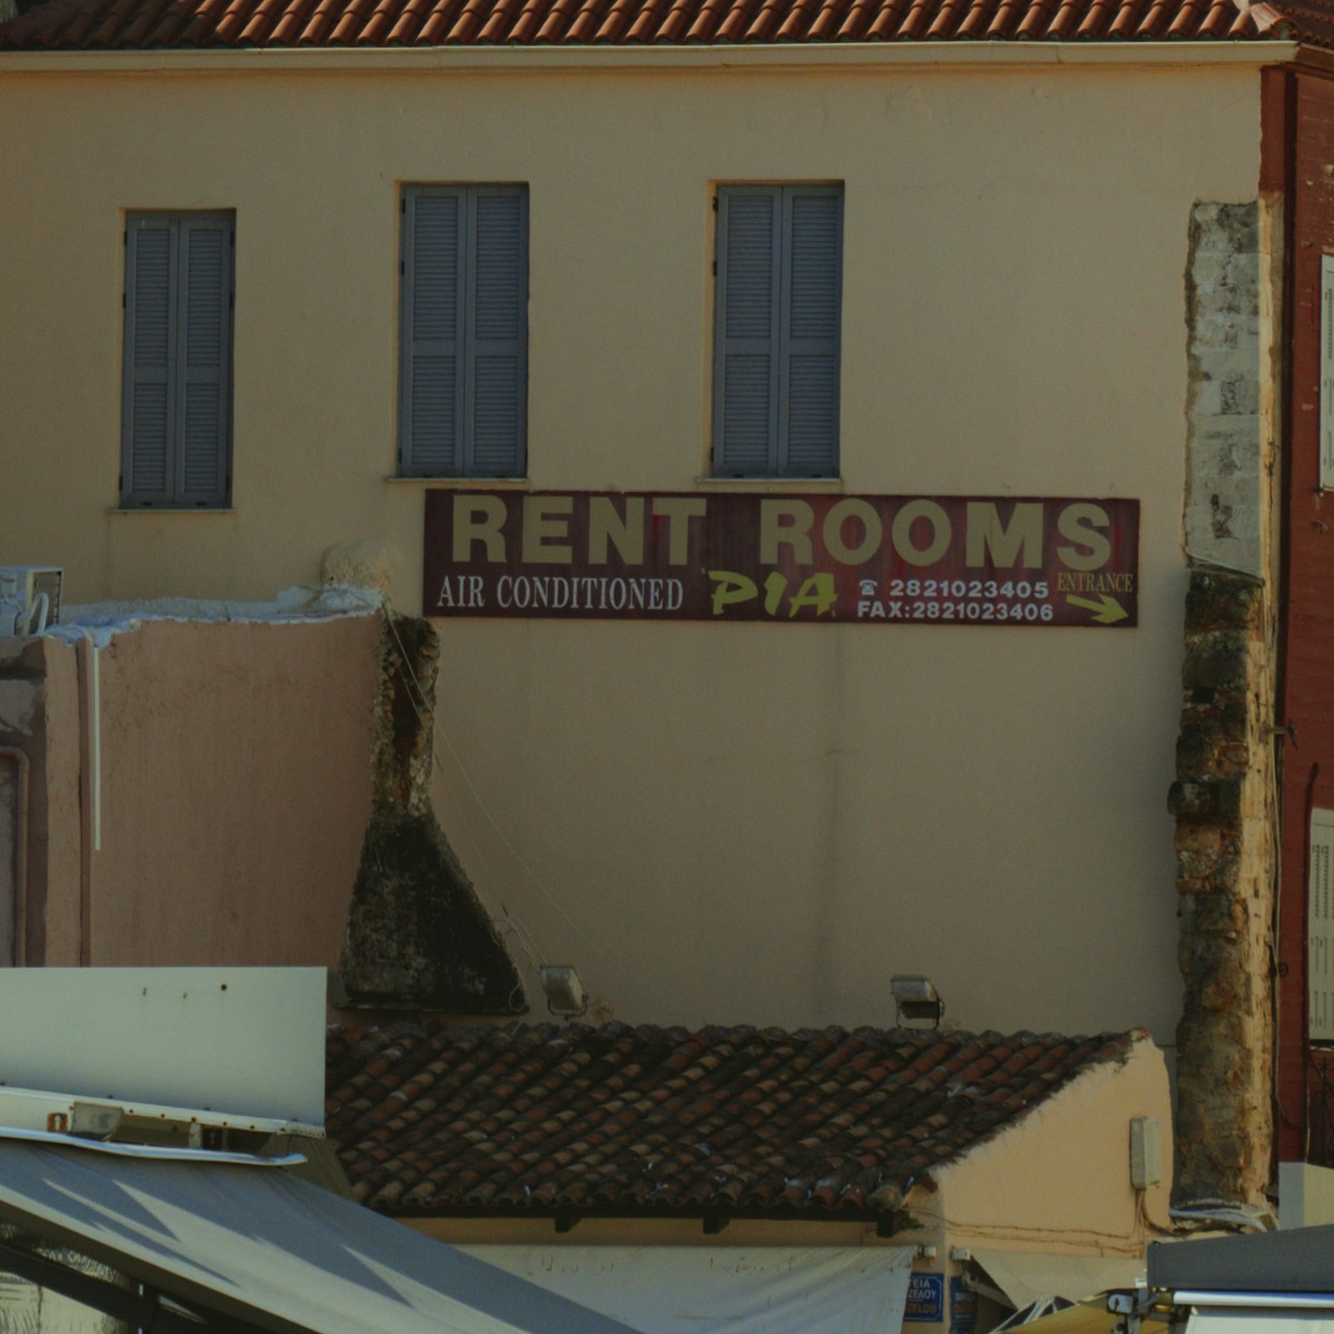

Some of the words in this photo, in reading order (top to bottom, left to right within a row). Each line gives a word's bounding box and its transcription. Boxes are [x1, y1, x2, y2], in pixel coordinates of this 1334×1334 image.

[452, 495, 707, 566] RENT
[759, 498, 1113, 572] ROOMS
[890, 579, 1050, 599] 2821023405
[1057, 571, 1134, 593] ENTRANCE
[437, 576, 485, 608] AIR
[496, 575, 684, 611] CONDITIONED
[708, 570, 838, 618] PIA
[857, 602, 1054, 621] FAX:2821023406
[907, 1290, 937, 1300] ΖΕΛΟΥ
[905, 1303, 937, 1314] ZELOU
